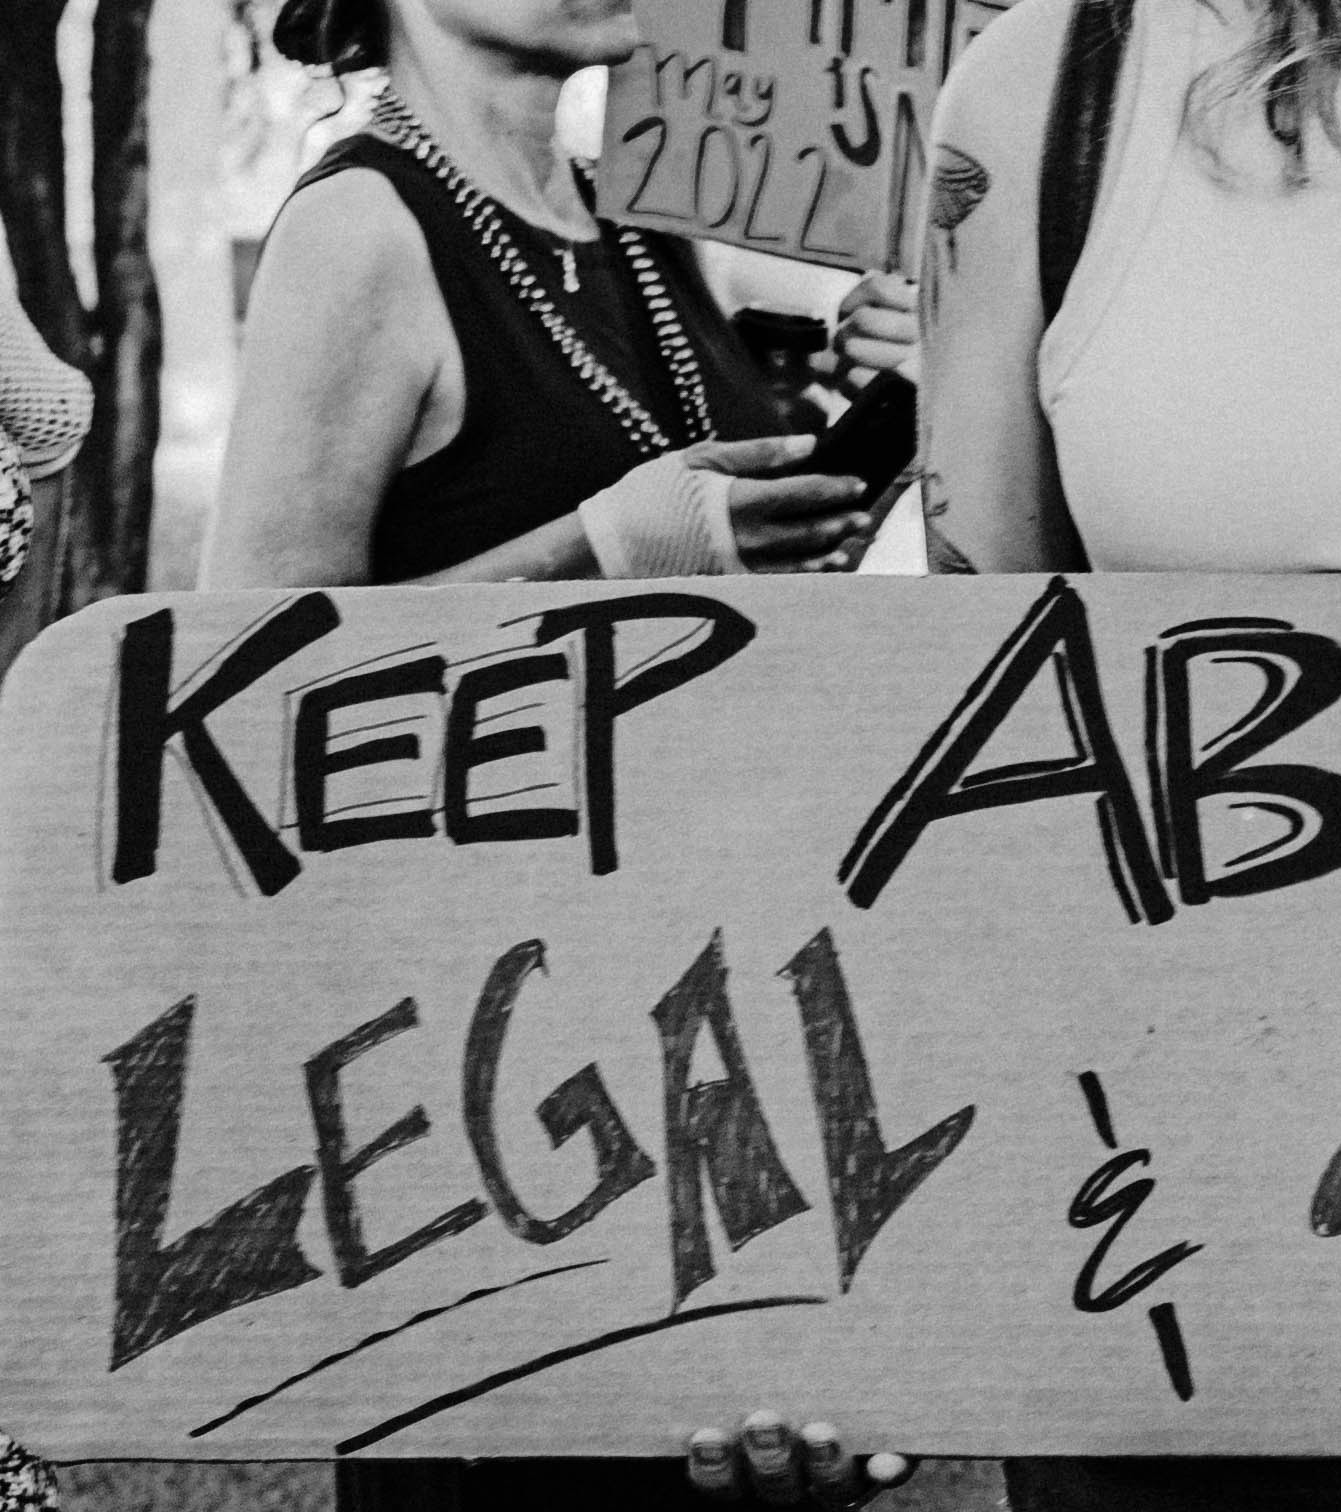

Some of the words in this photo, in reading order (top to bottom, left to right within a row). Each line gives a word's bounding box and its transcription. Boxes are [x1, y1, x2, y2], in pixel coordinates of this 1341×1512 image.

[622, 115, 857, 257] 2022
[98, 590, 757, 898] KEEP
[100, 926, 977, 1375] LEGAL
